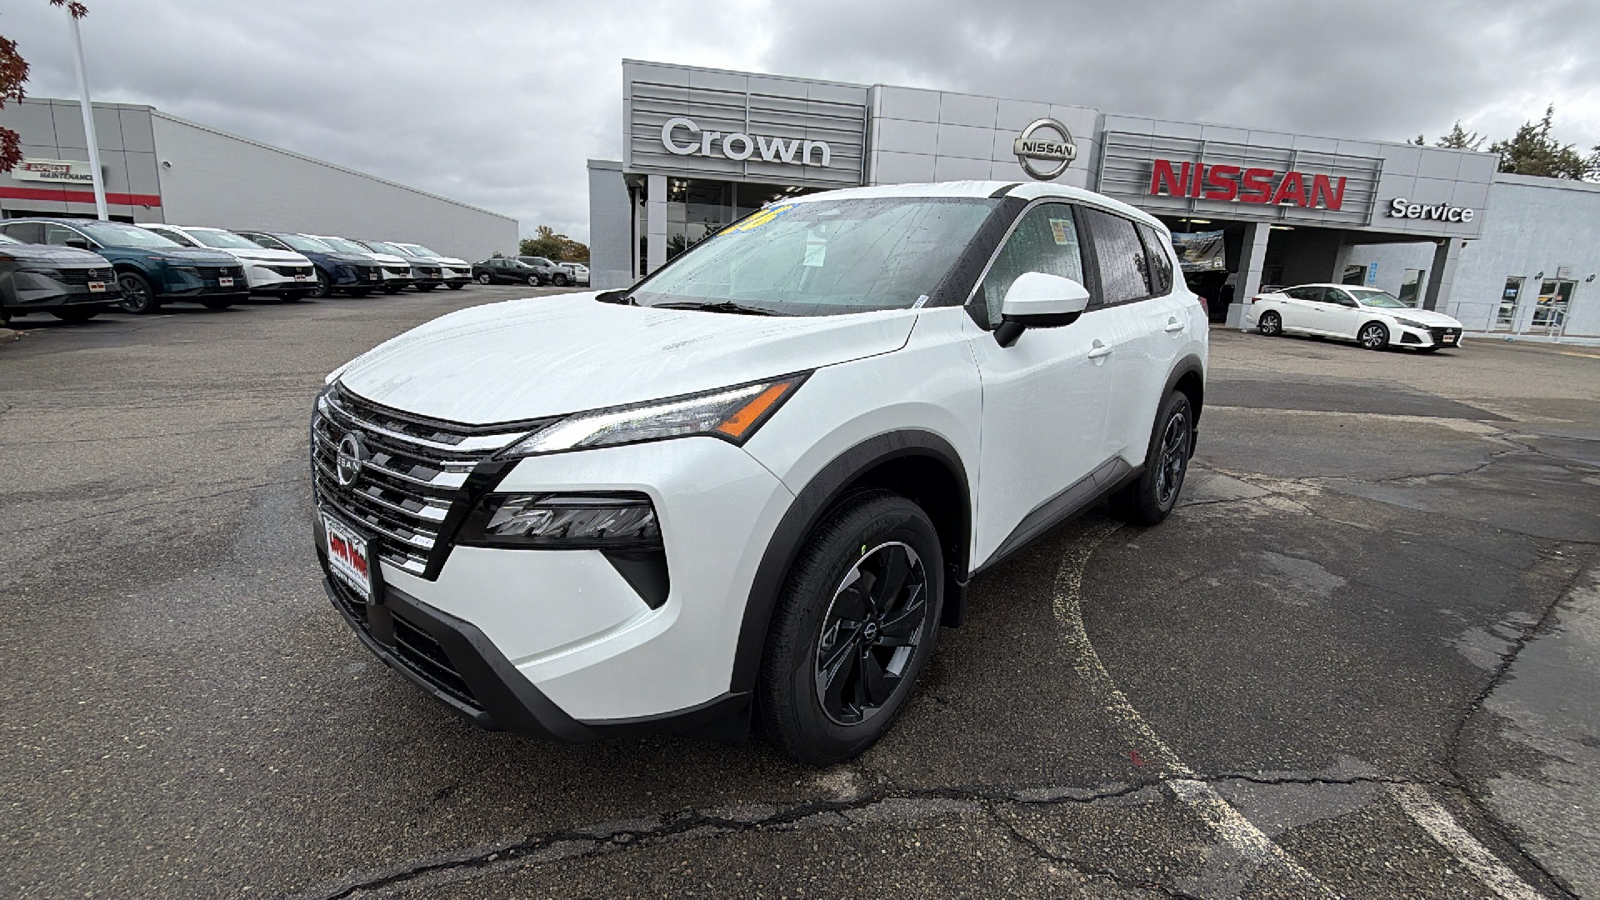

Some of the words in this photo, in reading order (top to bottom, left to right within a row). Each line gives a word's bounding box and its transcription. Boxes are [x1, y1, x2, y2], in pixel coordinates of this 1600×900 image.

[661, 117, 831, 167] Crown
[1021, 141, 1073, 156] NISSAN
[1149, 159, 1347, 211] NISSAN
[1389, 197, 1474, 223] Service
